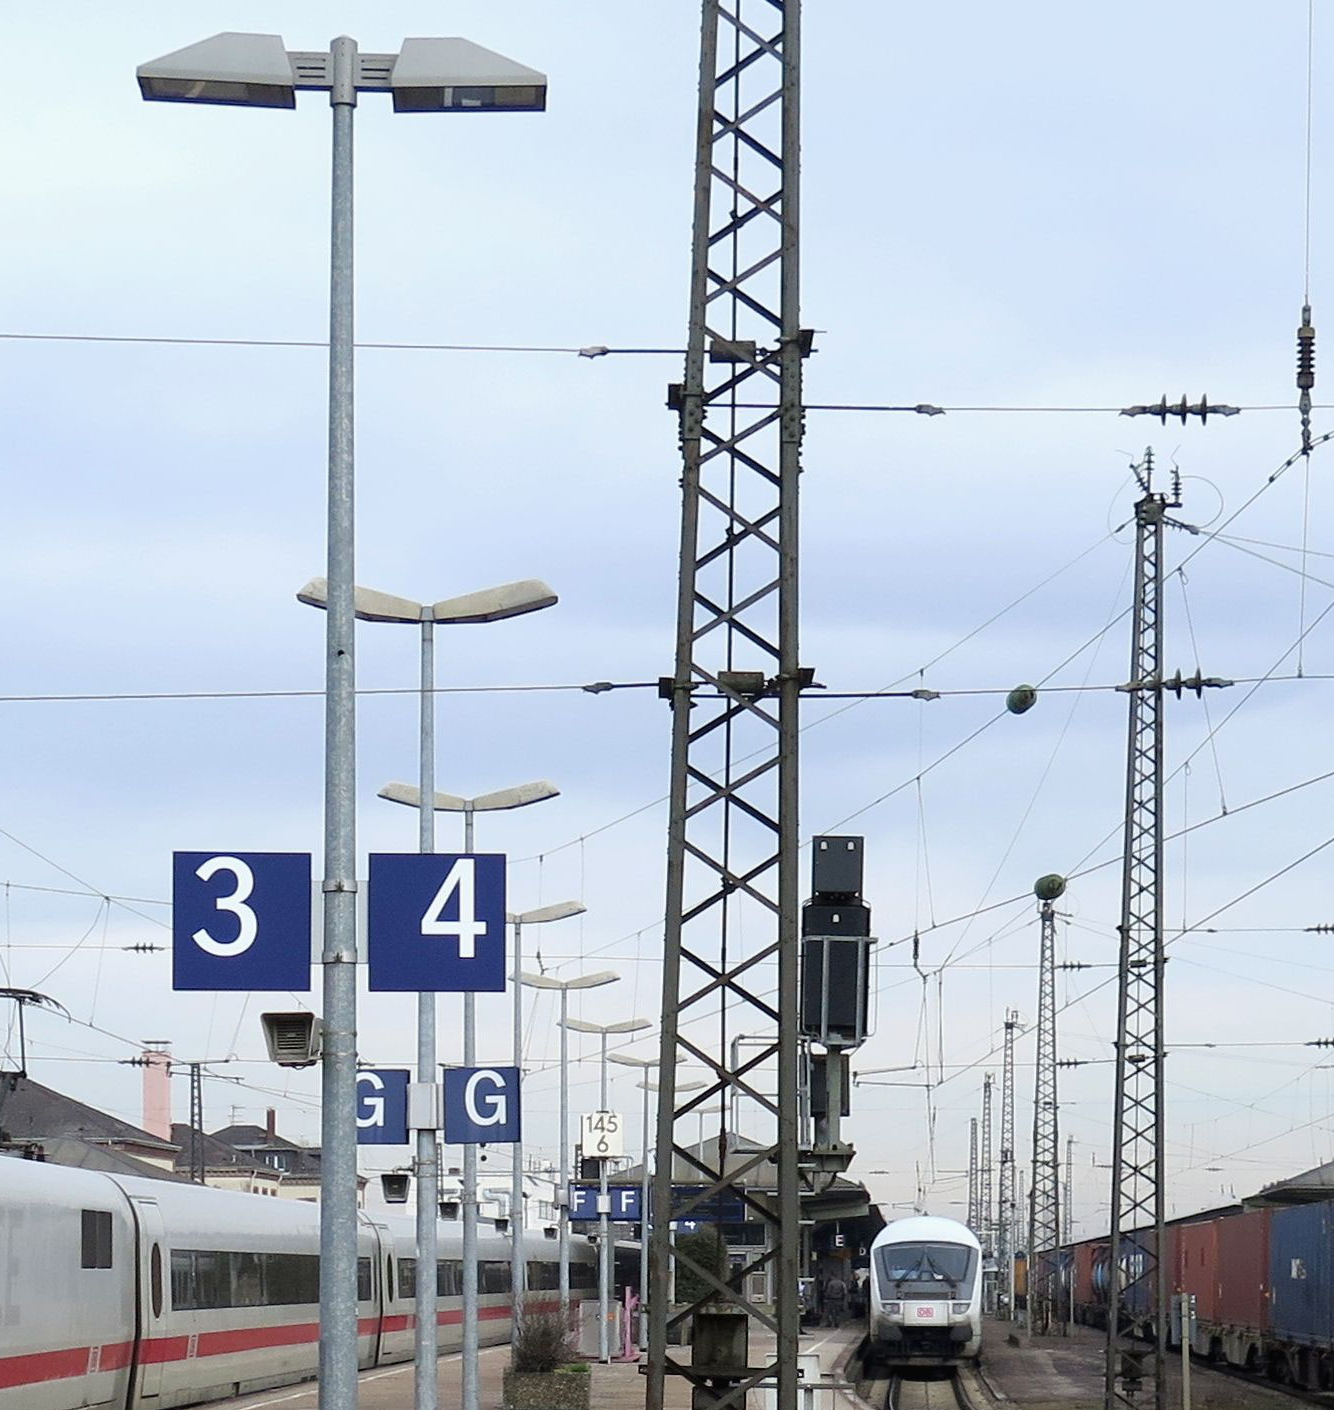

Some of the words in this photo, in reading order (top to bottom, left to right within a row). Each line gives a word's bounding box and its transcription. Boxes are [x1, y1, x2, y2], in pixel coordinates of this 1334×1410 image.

[191, 856, 258, 957] 3
[421, 858, 487, 958] 4
[465, 1070, 507, 1127] G
[586, 1115, 618, 1133] 145
[597, 1134, 609, 1153] 6
[573, 1190, 586, 1212] F
[621, 1190, 635, 1212] F
[835, 1234, 845, 1247] E
